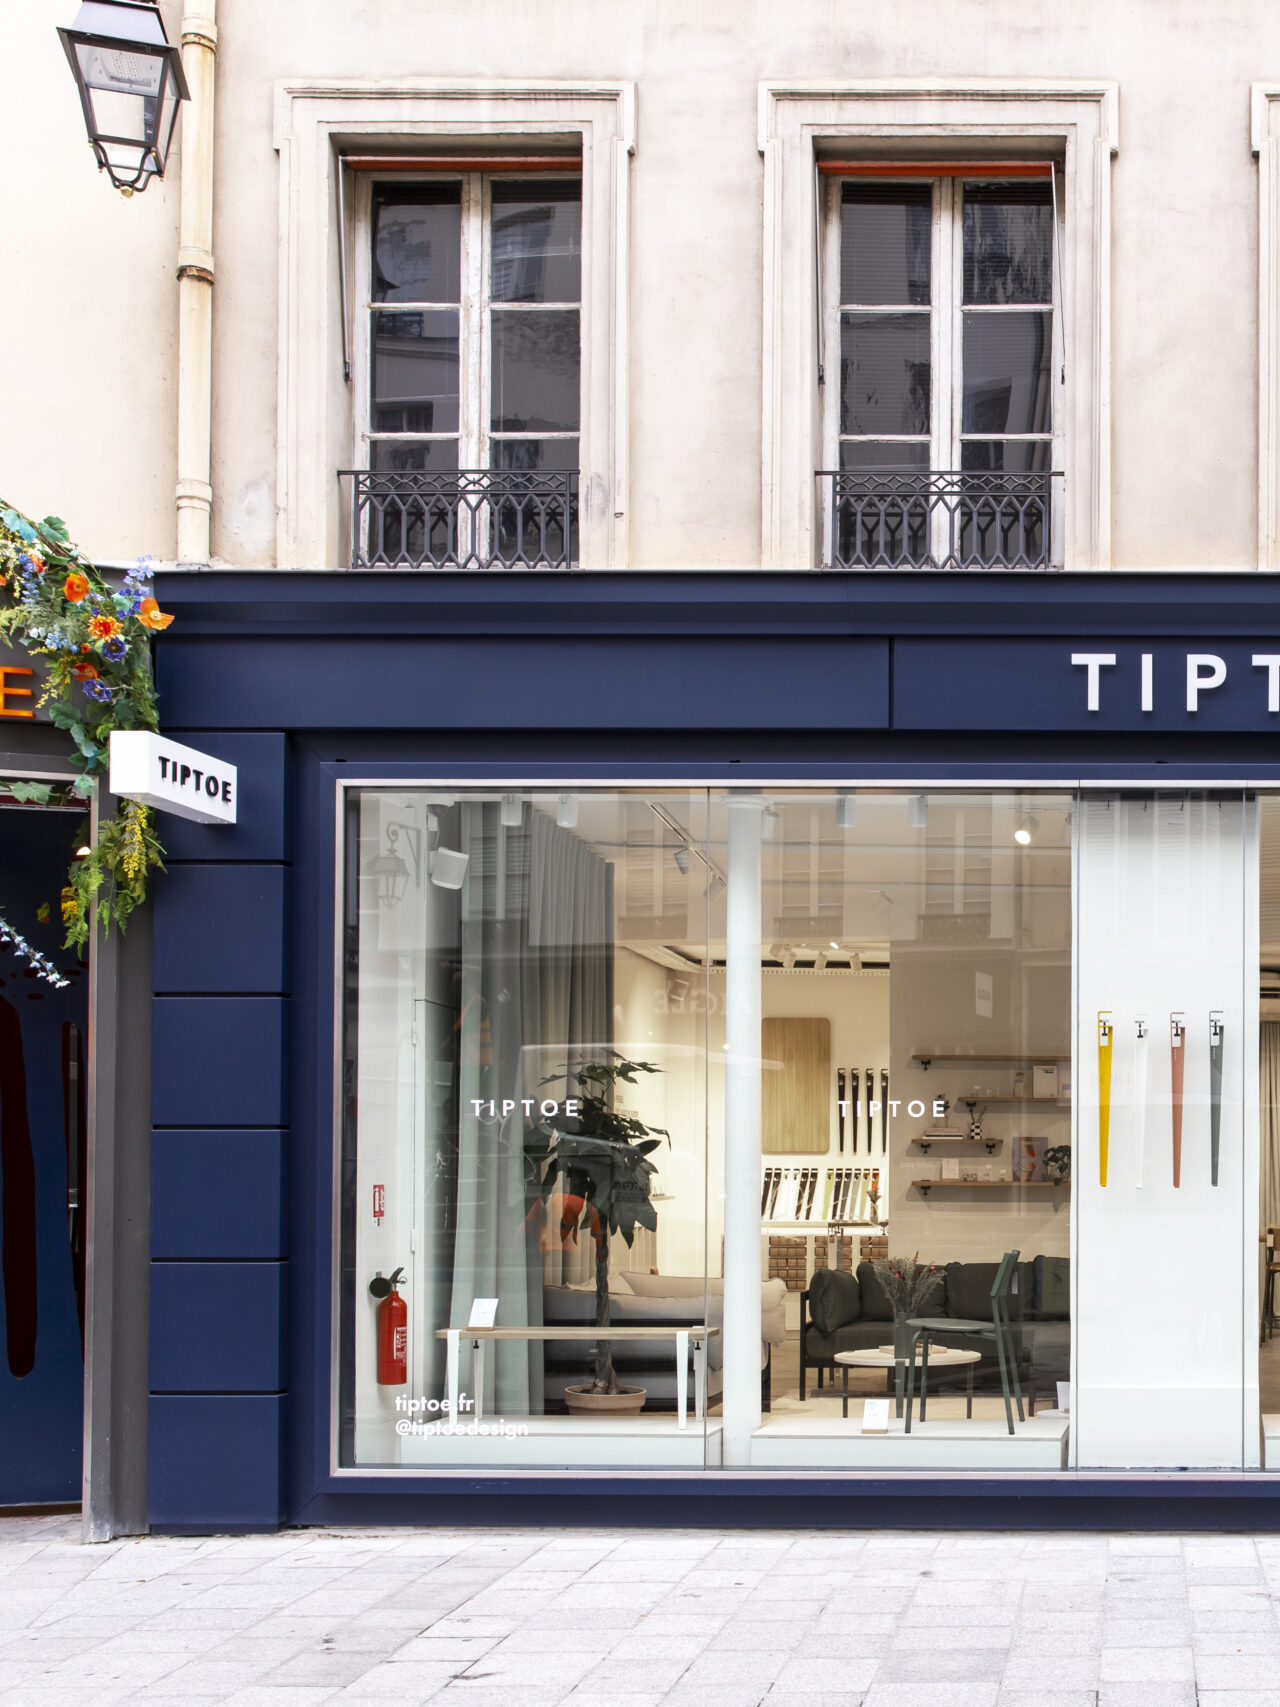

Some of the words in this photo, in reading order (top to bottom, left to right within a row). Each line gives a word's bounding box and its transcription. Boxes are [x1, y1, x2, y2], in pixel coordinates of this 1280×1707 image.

[158, 755, 232, 803] TIPTOE
[470, 1099, 578, 1117] TIPTOE
[837, 1100, 945, 1118] TIPTOE
[395, 1393, 474, 1416] tiptoe.fr
[395, 1417, 529, 1440] @tiptoedesign
